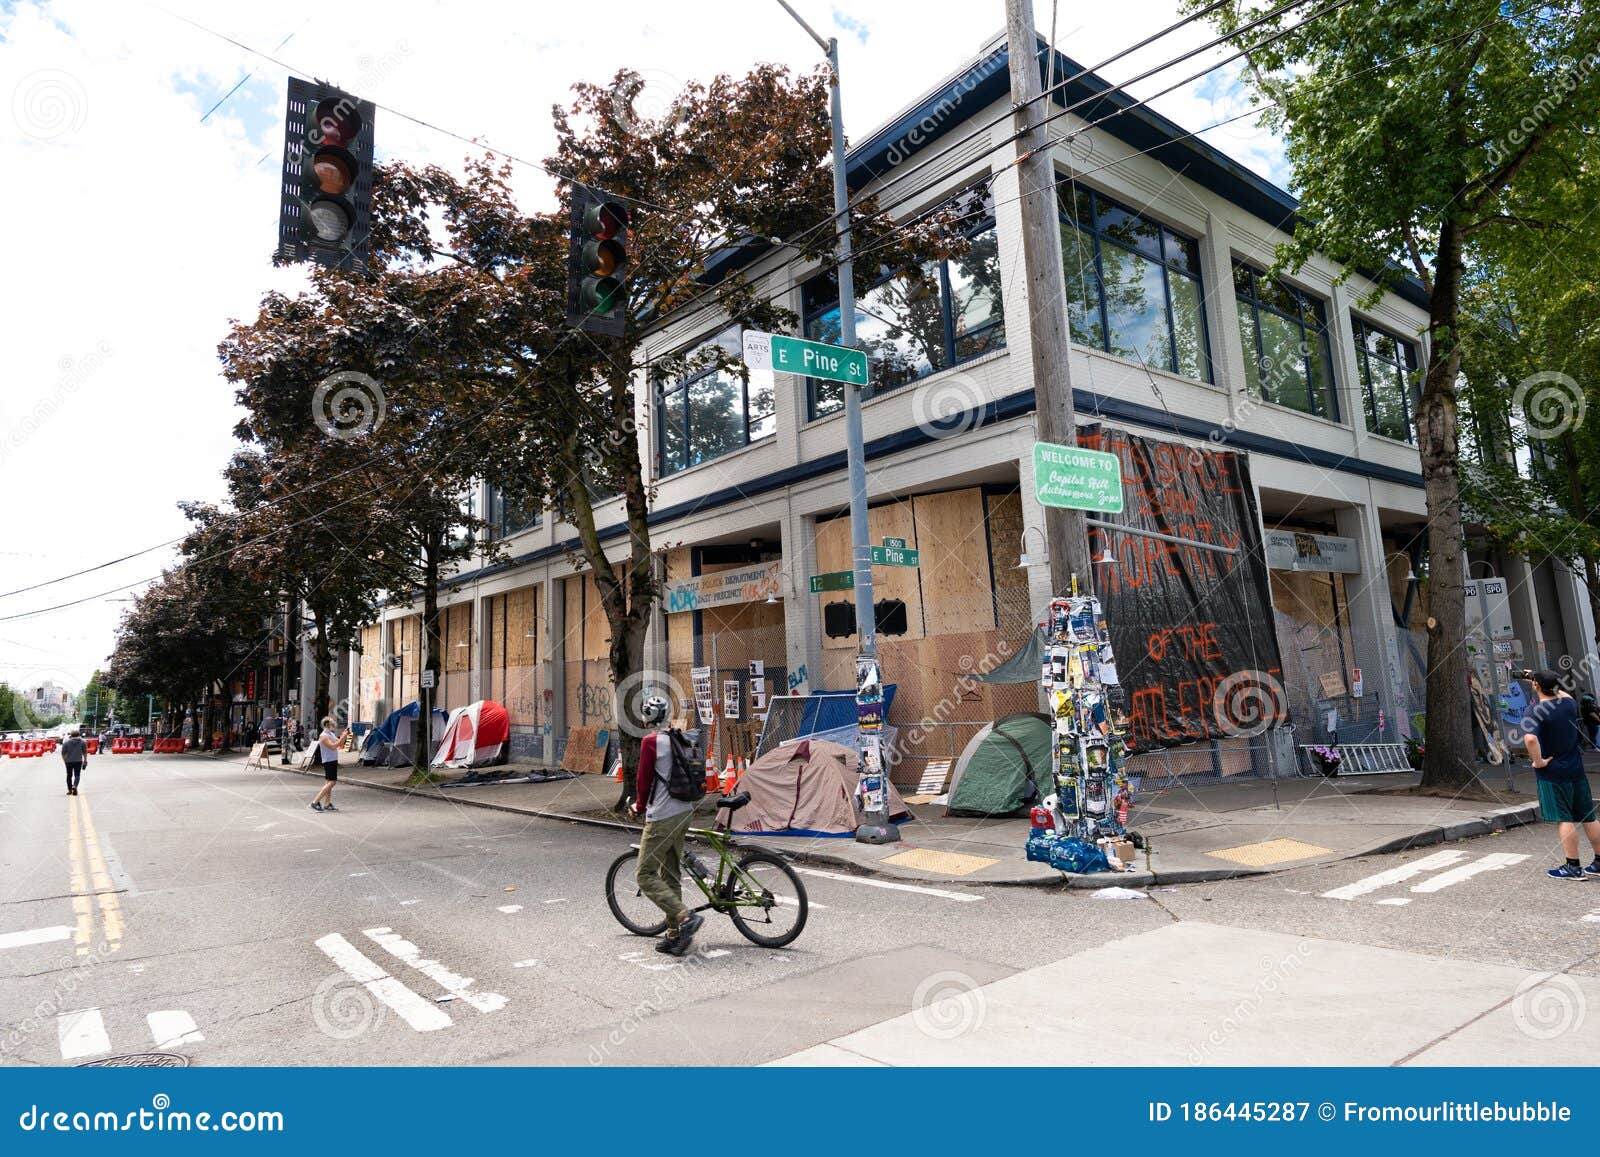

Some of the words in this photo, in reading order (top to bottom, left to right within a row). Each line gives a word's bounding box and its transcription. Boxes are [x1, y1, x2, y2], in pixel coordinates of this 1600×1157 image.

[747, 343, 769, 353] ARTS
[779, 349, 788, 363] E
[803, 349, 838, 372] Pine
[849, 362, 861, 377] St
[1041, 450, 1096, 469] WELCOME
[1098, 460, 1113, 471] TO
[1155, 444, 1243, 494] SPACE
[1049, 470, 1085, 487] Capitol
[1088, 477, 1109, 490] Hill
[1039, 483, 1094, 499] Autonomous
[1098, 491, 1121, 505] Zone
[1165, 488, 1198, 516] NOW
[873, 551, 879, 561] E
[885, 548, 904, 563] Pine
[1149, 629, 1173, 662] OF
[1176, 623, 1222, 662] THE
